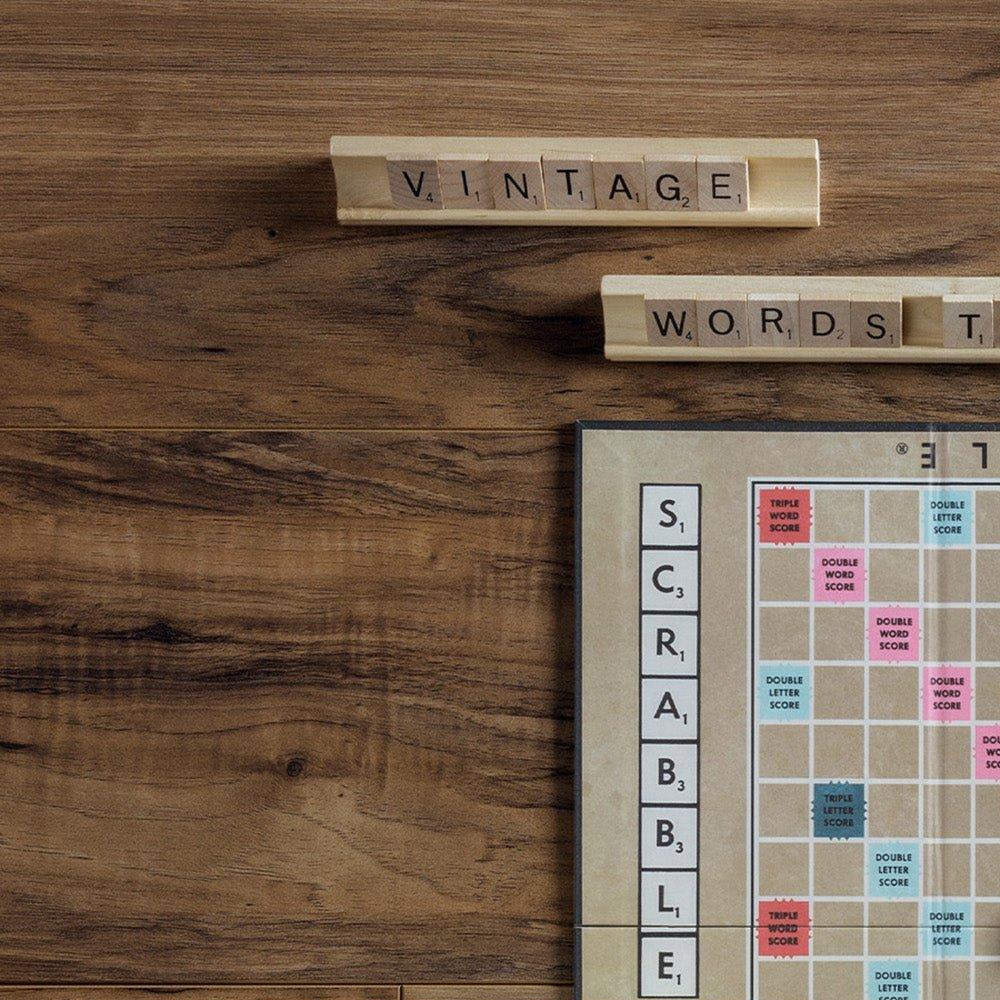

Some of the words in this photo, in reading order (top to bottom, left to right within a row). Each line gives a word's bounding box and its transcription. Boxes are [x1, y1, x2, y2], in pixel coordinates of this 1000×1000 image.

[770, 499, 800, 508] TRIPLE
[930, 500, 965, 510] DOUBLE
[769, 511, 799, 521] WORD
[933, 513, 962, 522] LETTER
[769, 523, 800, 533] SCORE
[933, 525, 962, 535] SCORE
[766, 676, 803, 685] DOUBLE
[769, 688, 800, 697] LETTER
[769, 701, 800, 710] SCORE
